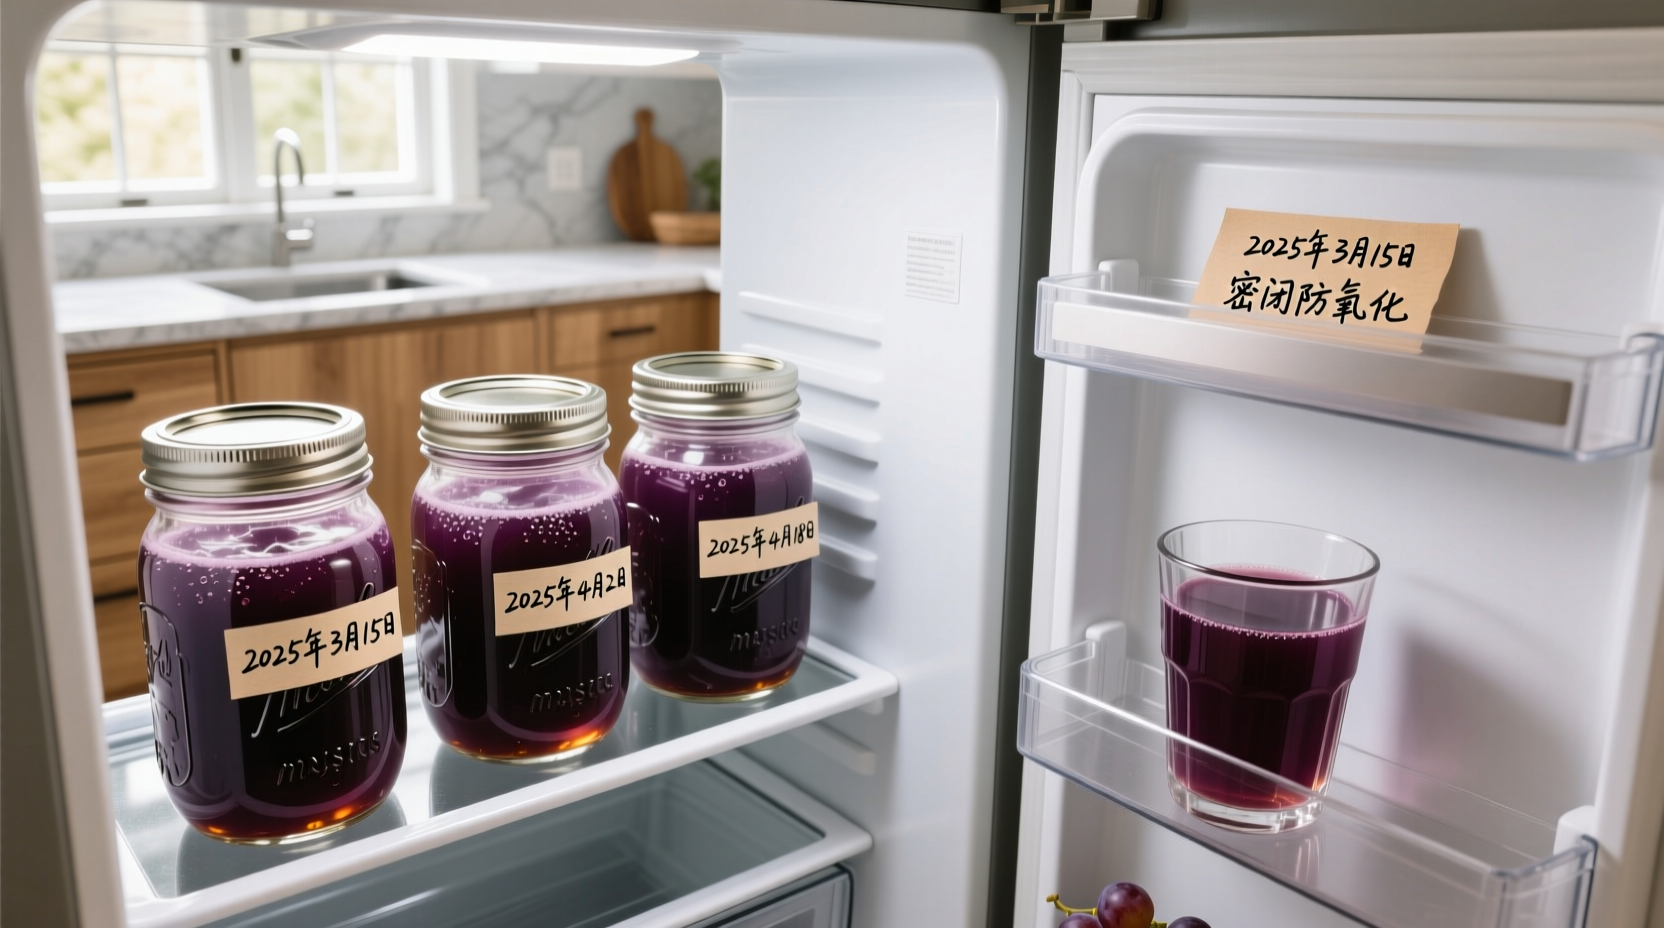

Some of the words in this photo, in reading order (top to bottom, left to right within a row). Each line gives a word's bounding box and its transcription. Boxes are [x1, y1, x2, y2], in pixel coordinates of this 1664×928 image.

[1243, 229, 1416, 269] 2025年3月15日
[1223, 270, 1409, 324] 密闭防氧化
[706, 520, 814, 559] 2025年4月18日
[504, 566, 626, 614] 2025年4月2日
[241, 611, 395, 674] 2025年3月15日
